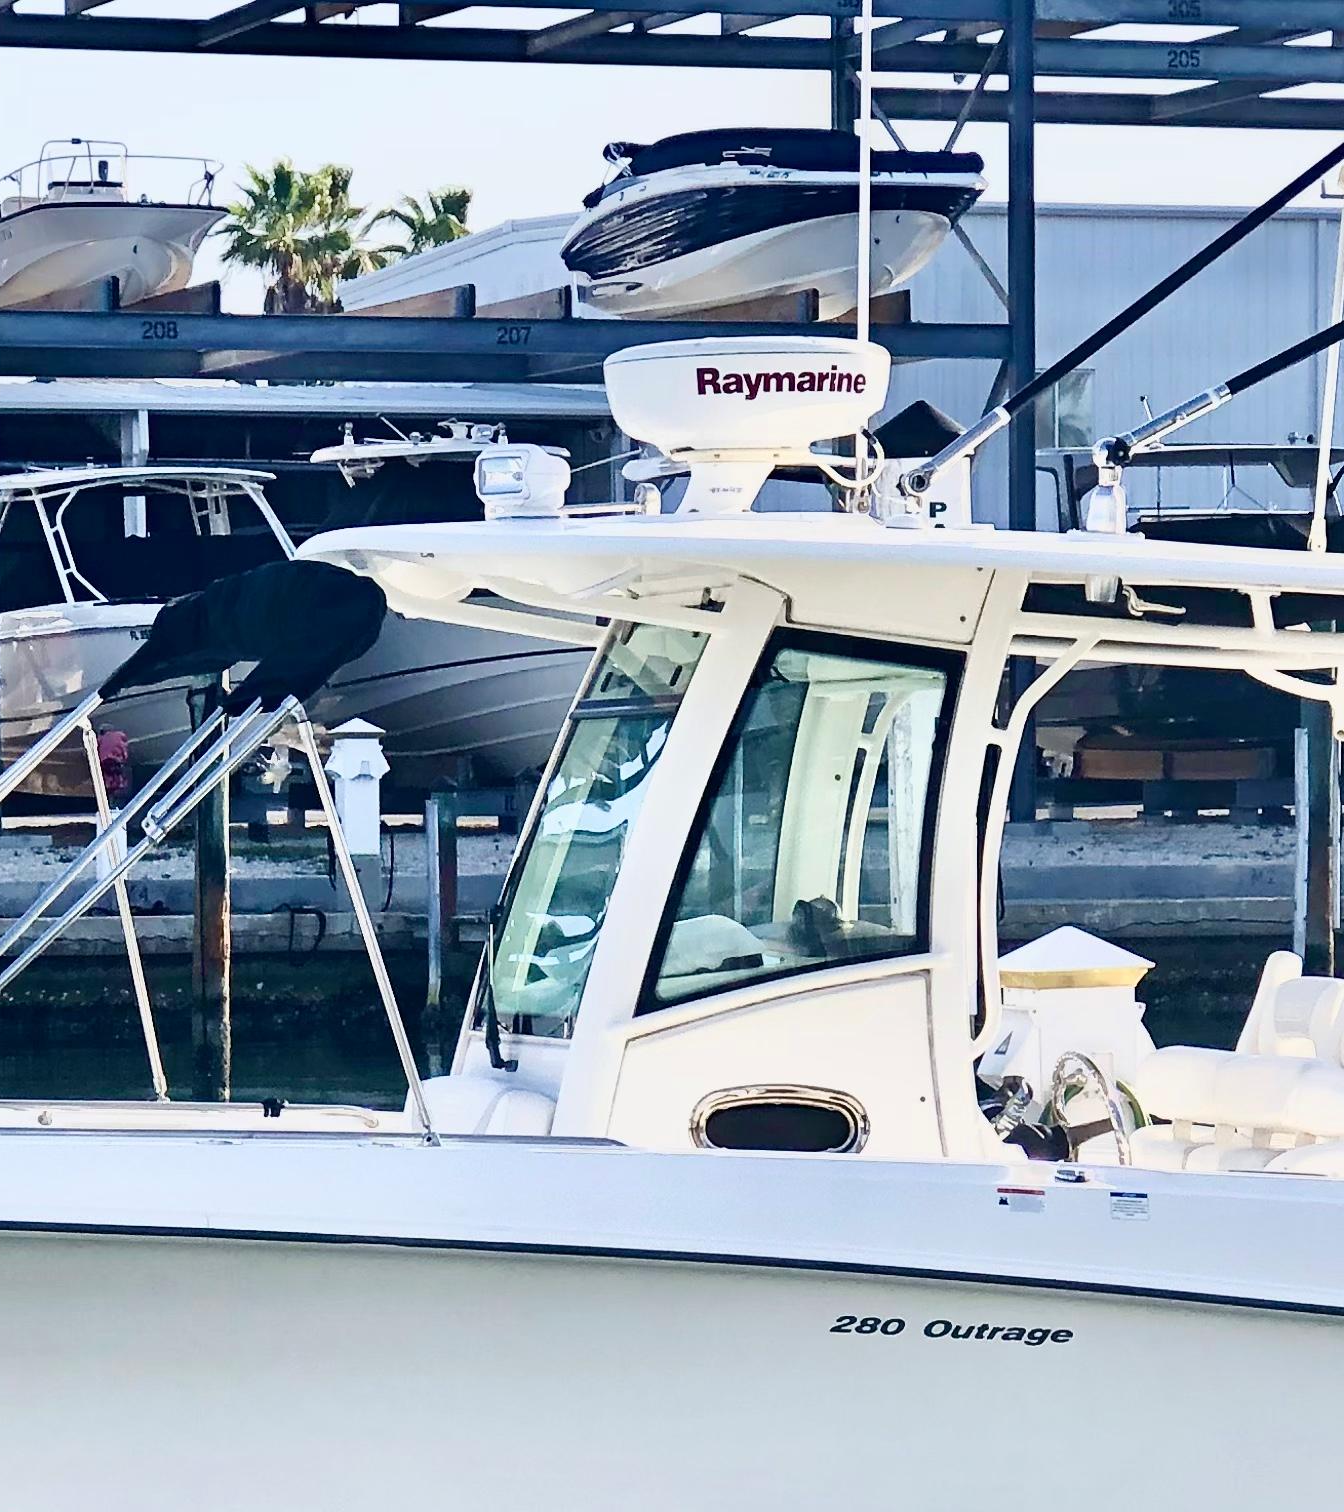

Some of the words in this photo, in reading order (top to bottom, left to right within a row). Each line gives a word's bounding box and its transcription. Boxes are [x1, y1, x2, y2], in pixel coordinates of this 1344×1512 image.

[1168, 49, 1200, 68] 205
[142, 320, 179, 339] 208
[496, 326, 531, 345] 207
[696, 365, 866, 400] Raymarine
[830, 1315, 905, 1336] 280
[923, 1319, 1074, 1346] Outrage
